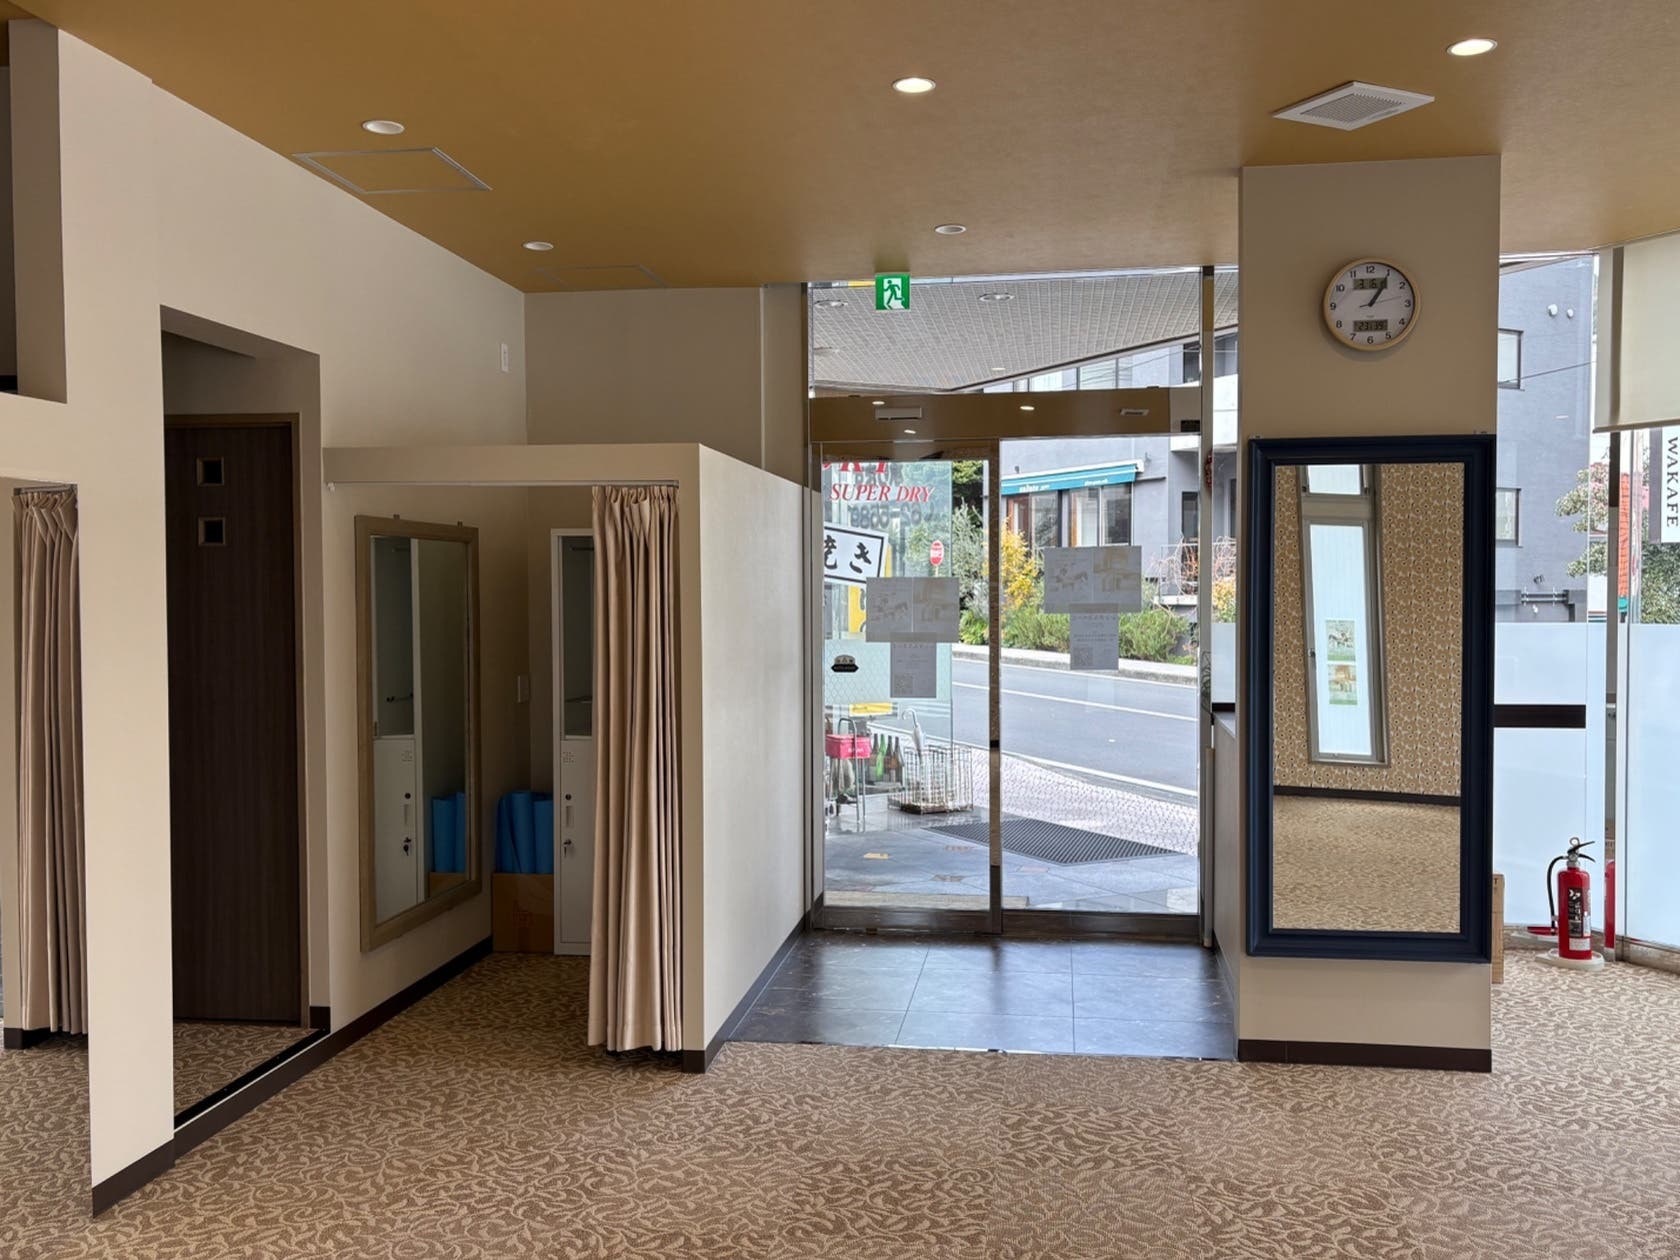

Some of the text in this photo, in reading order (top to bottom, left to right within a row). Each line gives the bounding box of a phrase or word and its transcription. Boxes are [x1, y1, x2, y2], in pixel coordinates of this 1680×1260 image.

[1350, 270, 1357, 278] 11
[1366, 265, 1375, 274] 12
[1336, 284, 1345, 292] 10
[1399, 281, 1406, 290] 2
[1330, 302, 1337, 311] 9
[1404, 300, 1411, 308] 3
[1336, 320, 1343, 329] 8
[1398, 318, 1405, 326] 4
[1350, 332, 1357, 341] 7
[1367, 336, 1374, 344] 6
[1385, 331, 1392, 340] 5
[1666, 436, 1679, 528] WAKAFE
[829, 483, 935, 503] SUPER DRY
